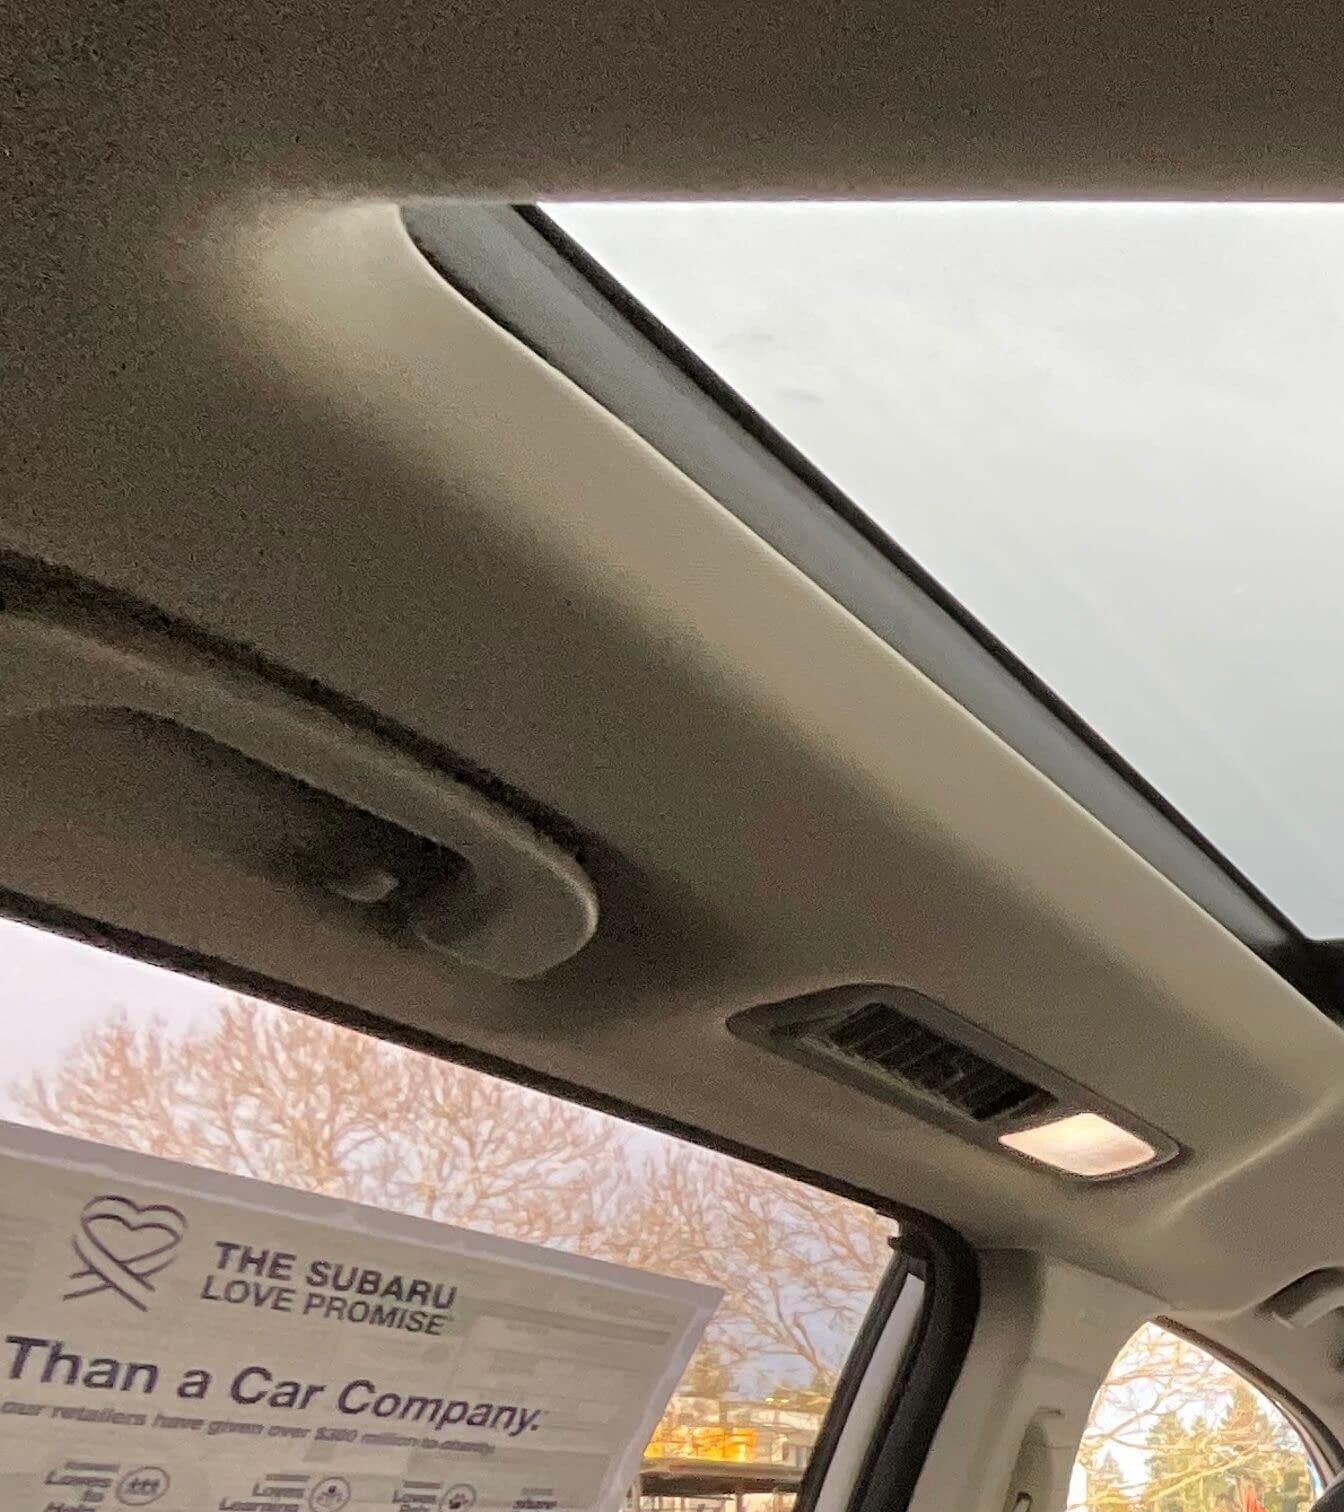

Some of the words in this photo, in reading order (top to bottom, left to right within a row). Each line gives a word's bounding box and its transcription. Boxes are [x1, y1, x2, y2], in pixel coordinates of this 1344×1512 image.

[200, 1274, 298, 1313] LOVE
[302, 1291, 449, 1337] PROMISE
[214, 1240, 298, 1282] THE
[305, 1259, 459, 1311] SUBARU
[4, 1334, 160, 1394] Than
[176, 1368, 212, 1400] a
[229, 1365, 328, 1411] Car
[337, 1378, 542, 1438] Company.
